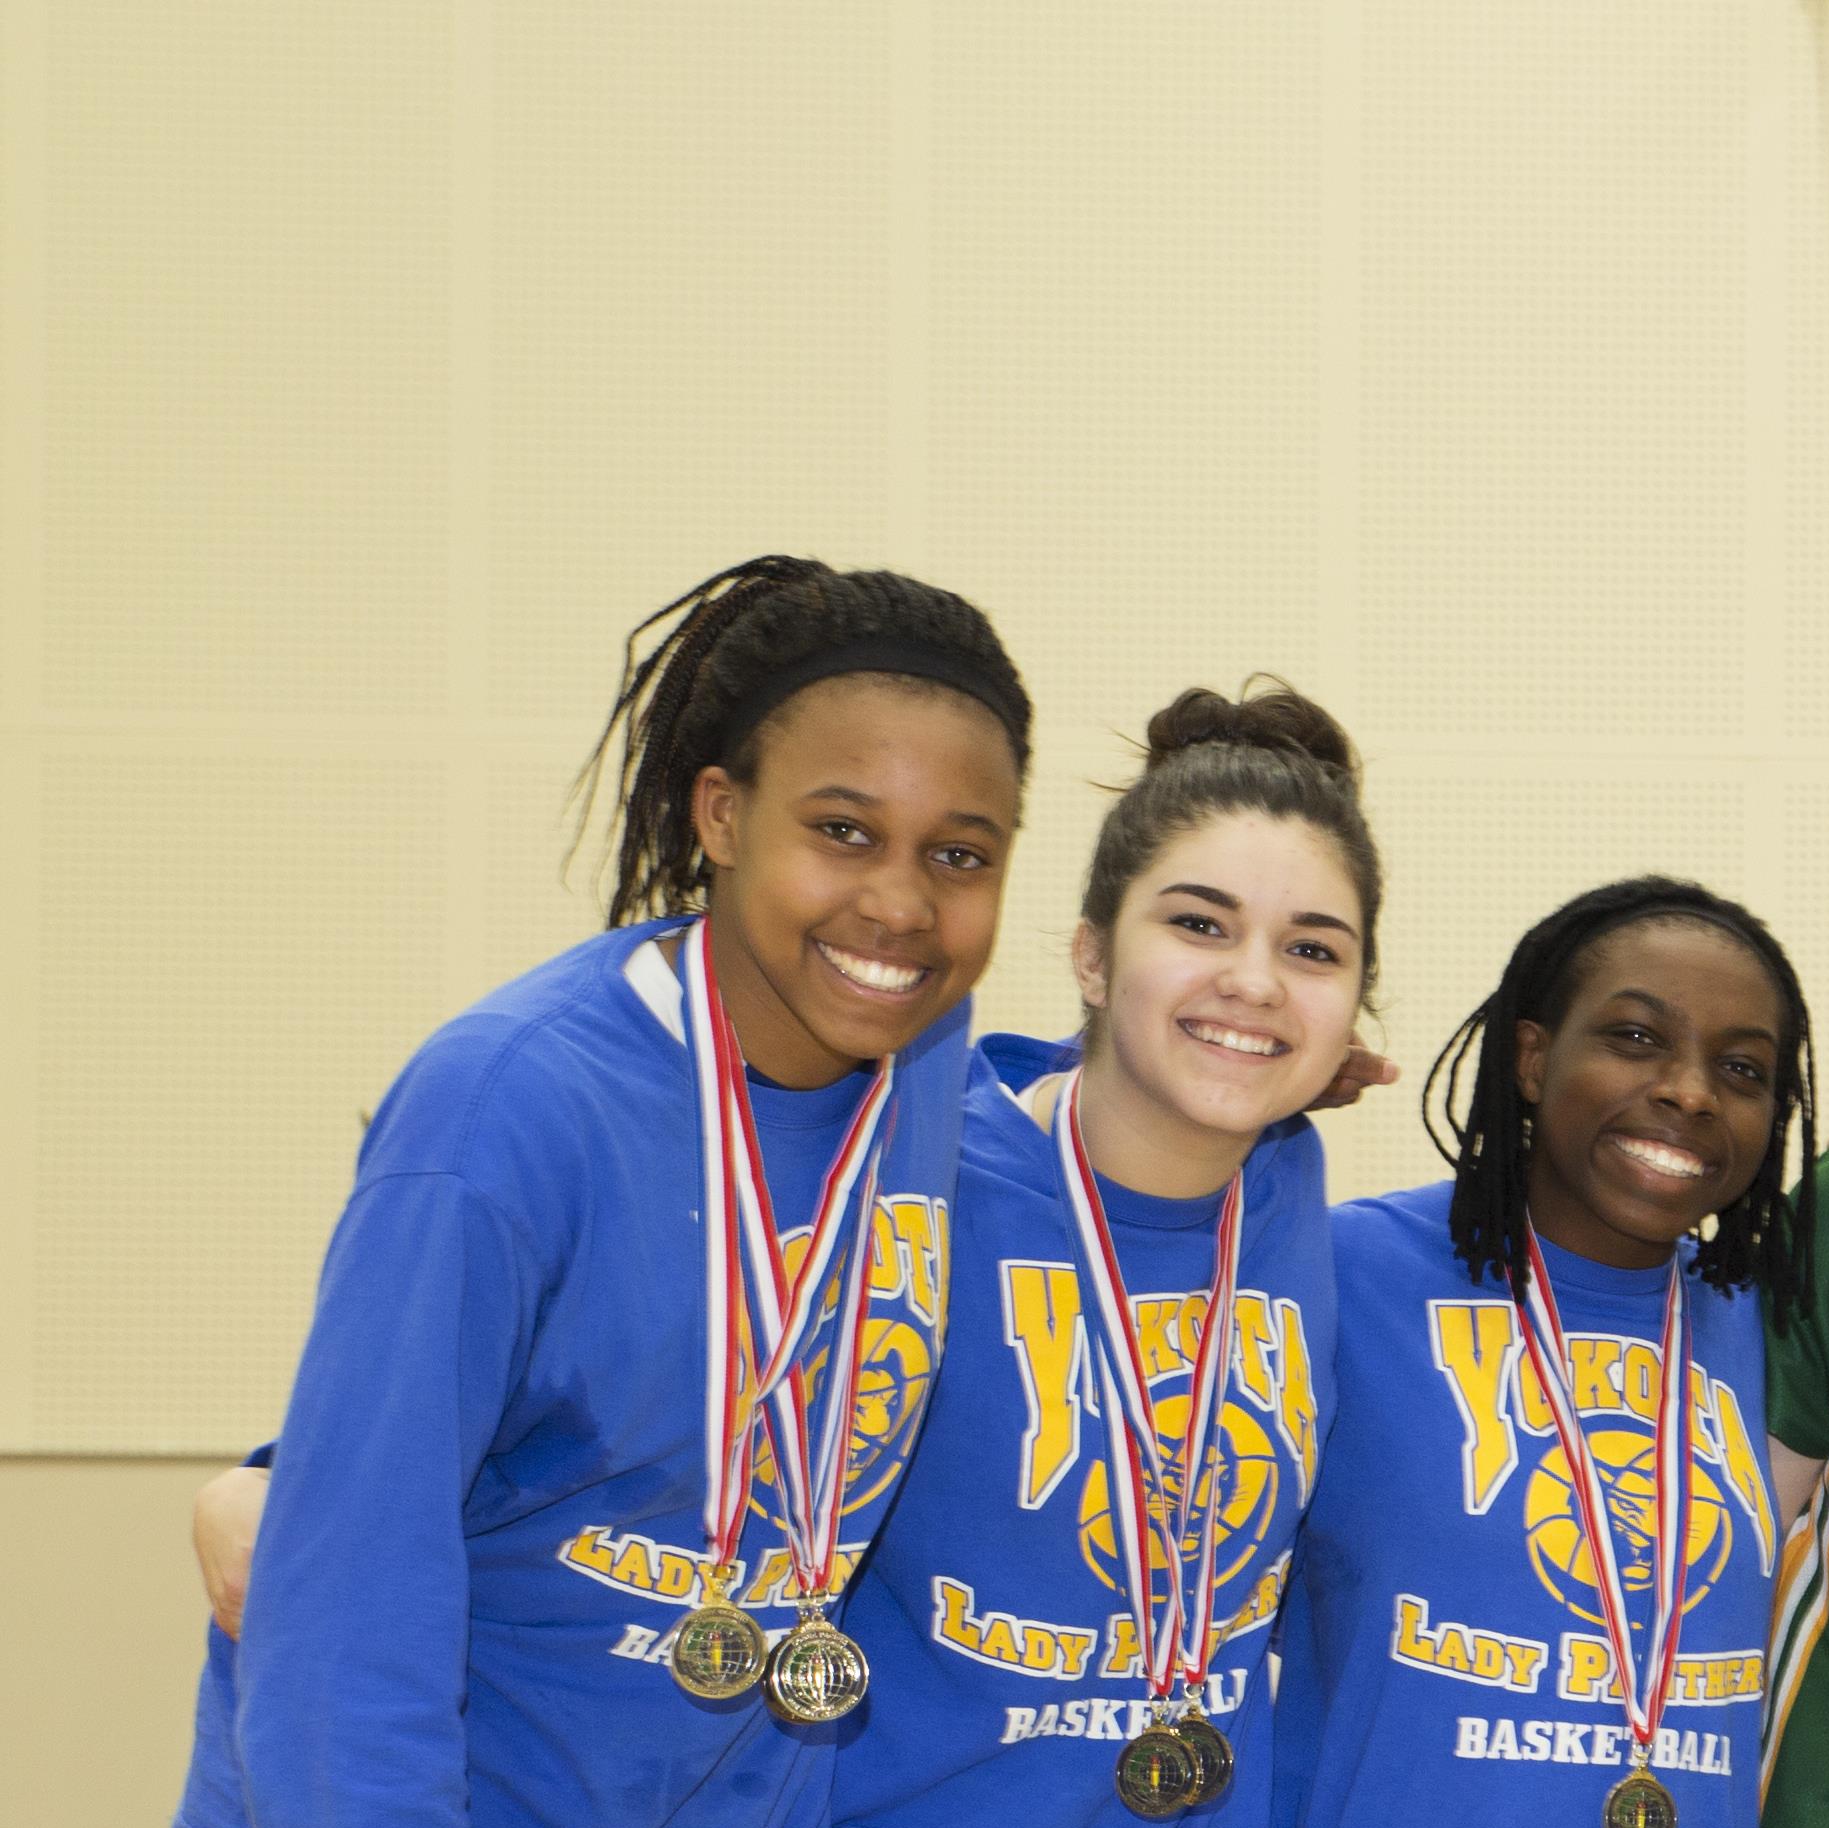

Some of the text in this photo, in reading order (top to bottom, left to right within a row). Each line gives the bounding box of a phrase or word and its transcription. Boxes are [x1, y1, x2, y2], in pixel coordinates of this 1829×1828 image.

[998, 1259, 1318, 1510] YKOTA
[932, 1575, 1098, 1681] LADY
[1390, 1594, 1548, 1693] LADY
